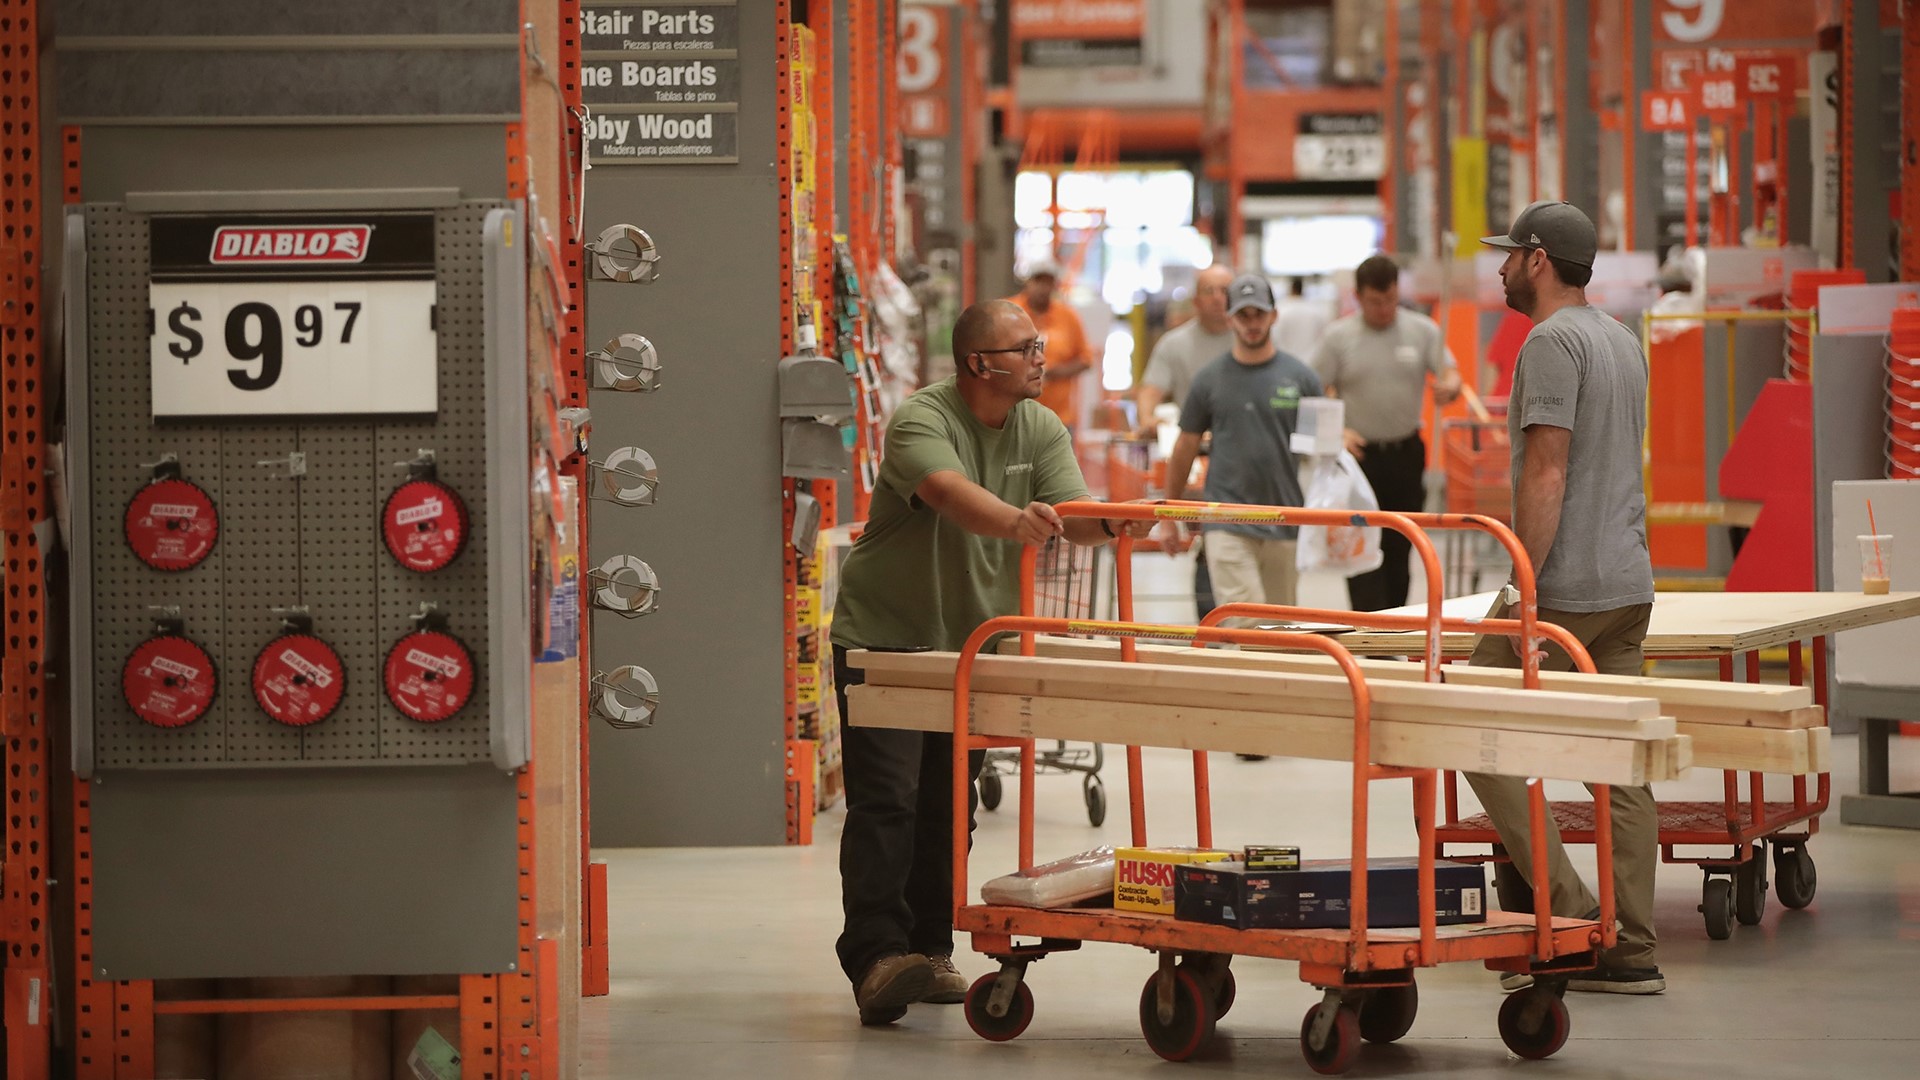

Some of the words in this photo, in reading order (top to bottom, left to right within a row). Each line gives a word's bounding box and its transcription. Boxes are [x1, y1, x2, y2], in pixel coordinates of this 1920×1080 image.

[642, 10, 715, 35] Parts
[623, 39, 651, 50] Piezas
[652, 41, 672, 51] para
[673, 39, 714, 50] escaleras
[581, 65, 612, 87] ne
[621, 61, 717, 87] Boards
[654, 90, 683, 101] Tablas
[684, 90, 696, 101] de
[697, 91, 716, 103] pino
[583, 115, 630, 145] bby
[637, 114, 713, 140] Wood
[603, 144, 636, 155] Madera
[637, 146, 658, 157] para
[659, 145, 713, 156] pasatiempos
[220, 232, 330, 257] DIABLO
[168, 301, 204, 366] $
[224, 302, 284, 392] 9
[1118, 885, 1148, 895] Contractor
[1145, 896, 1161, 906] Bags
